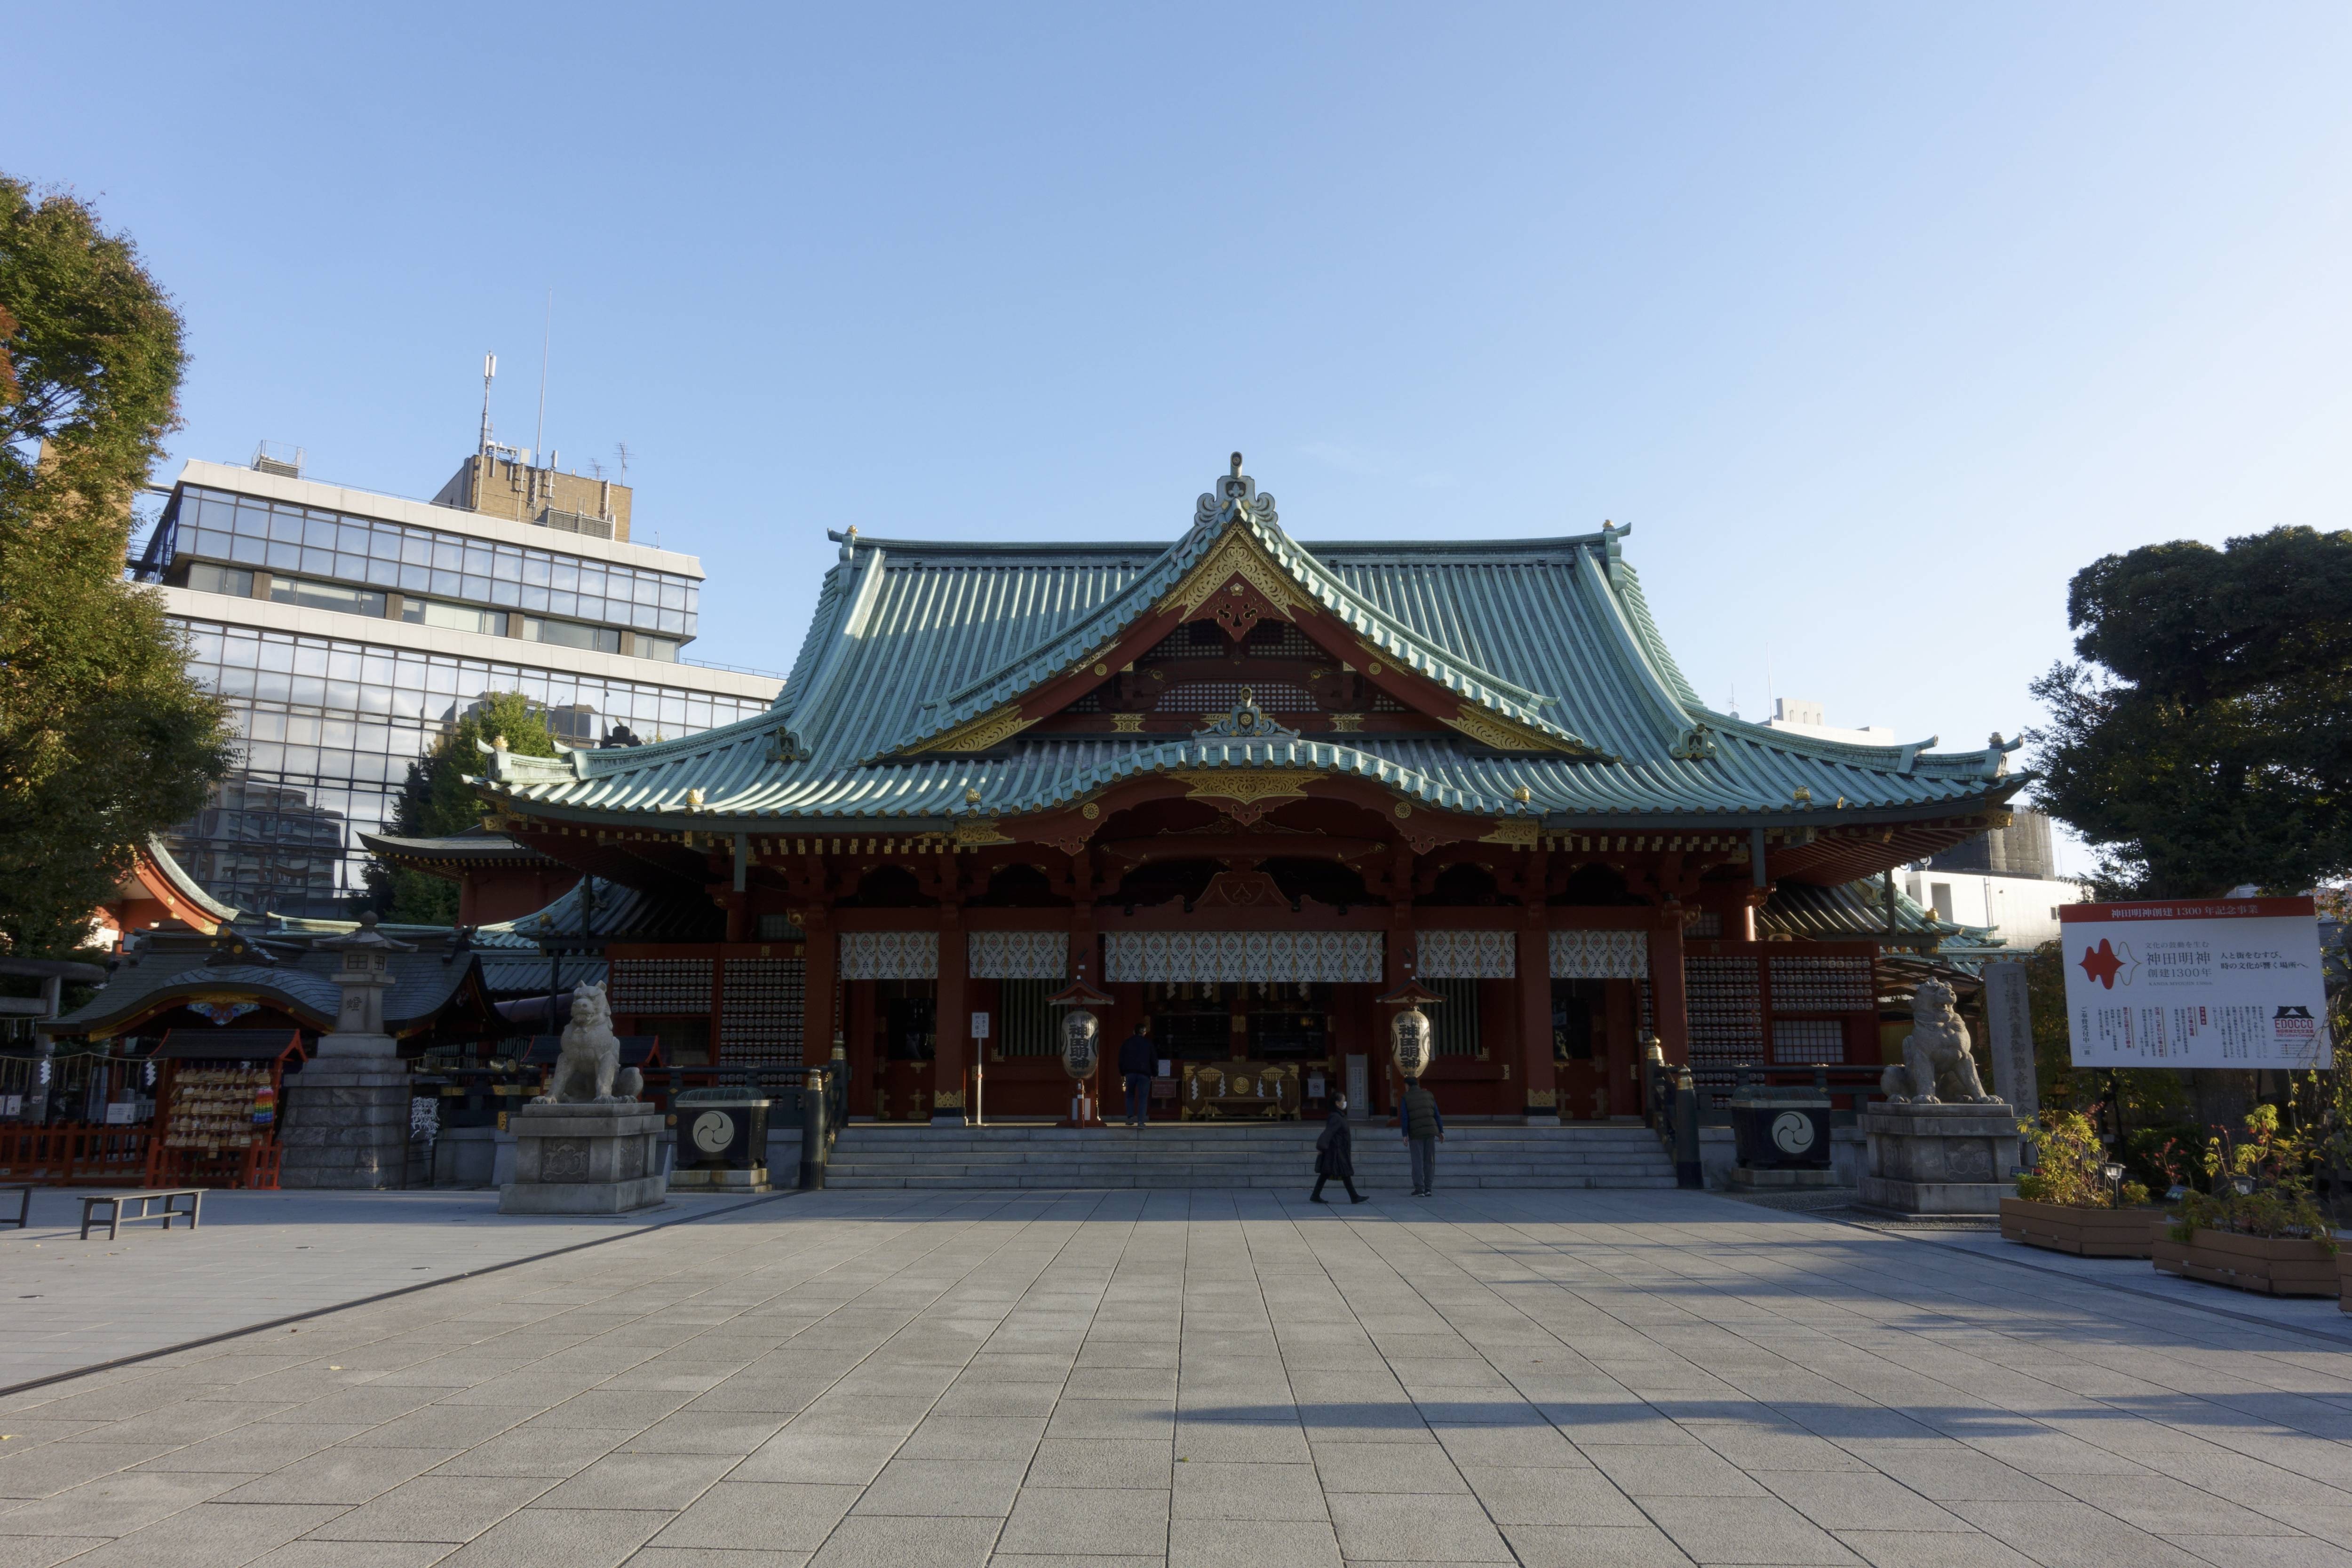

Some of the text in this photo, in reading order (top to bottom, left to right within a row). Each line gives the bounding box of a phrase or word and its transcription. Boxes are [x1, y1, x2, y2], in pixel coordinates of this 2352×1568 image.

[2112, 905, 2258, 918] 神田明神創建 1300 年記念事業
[2146, 951, 2211, 965] 神田明神
[2148, 968, 2212, 978] 創建1300年
[2275, 1019, 2313, 1029] EDOCCO
[1069, 1024, 1089, 1069] 神田明神
[1398, 1024, 1421, 1068] 神田明神
